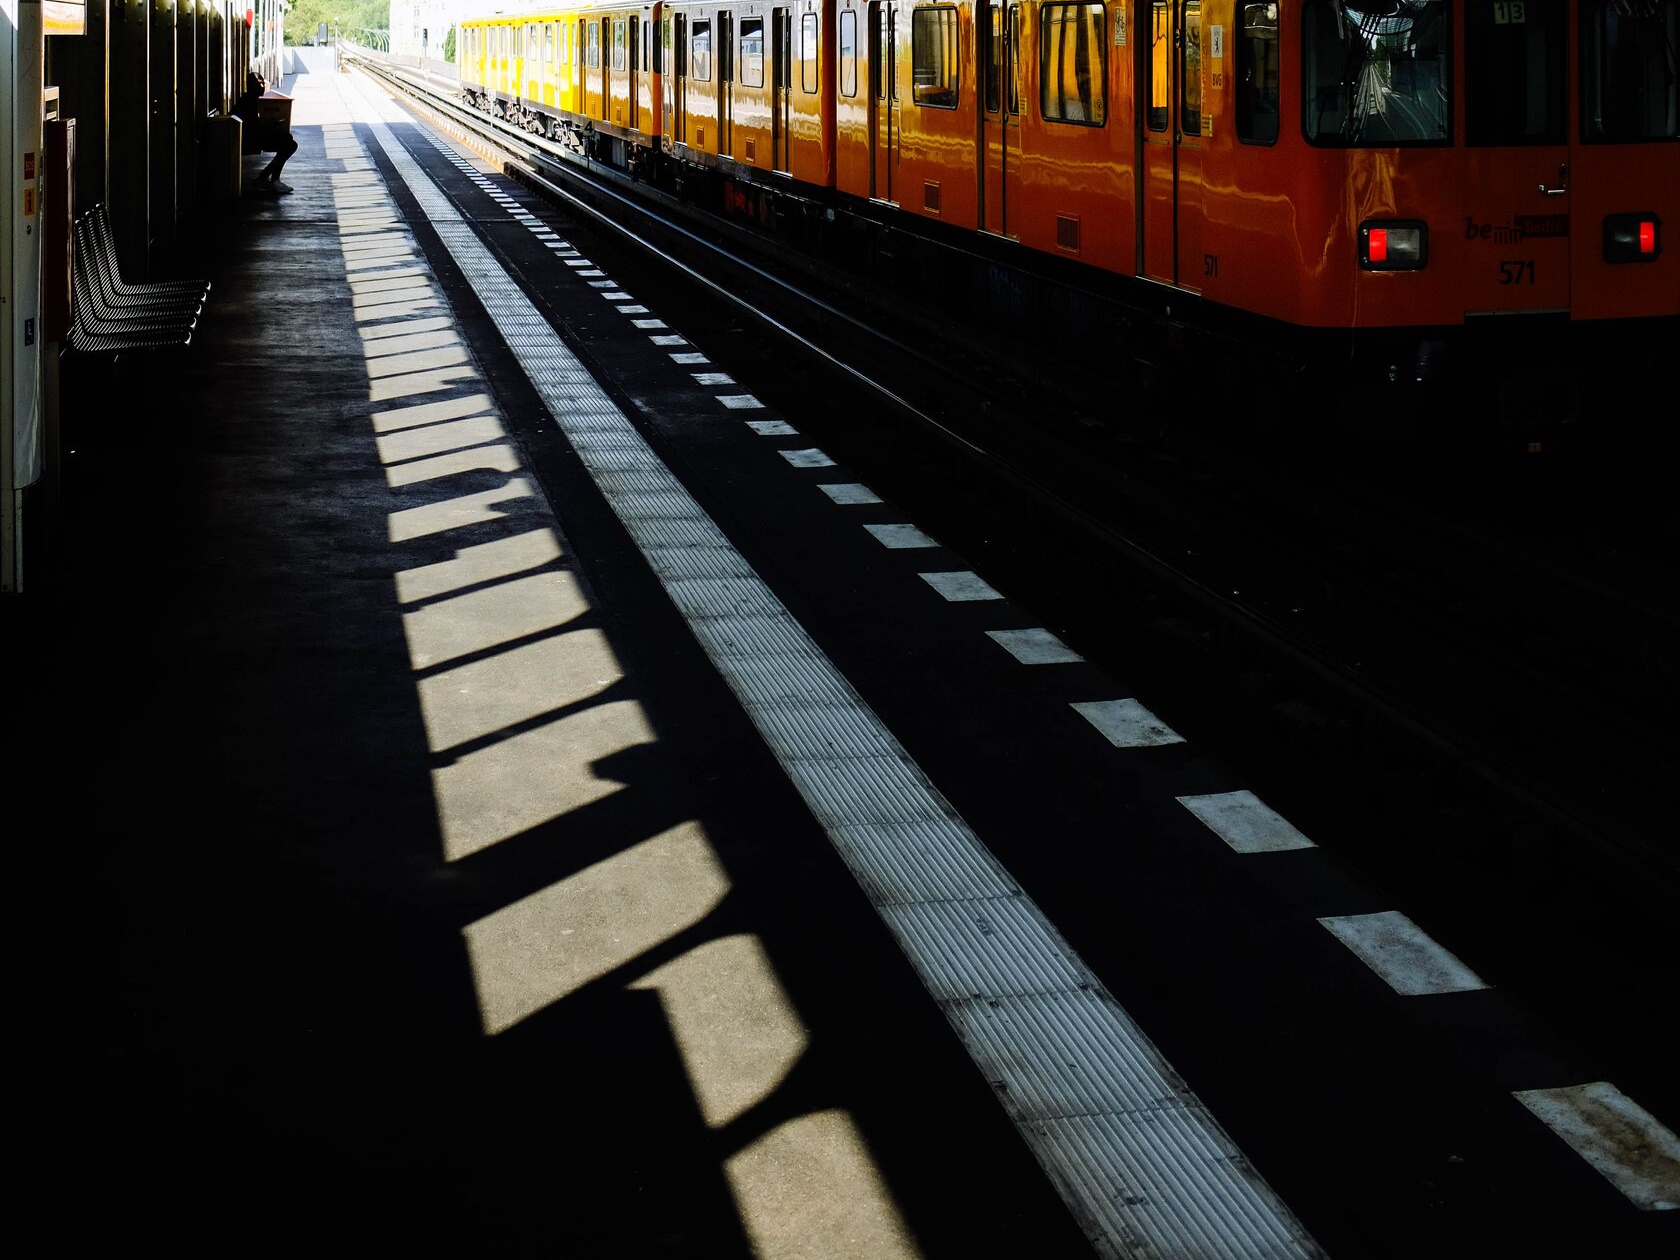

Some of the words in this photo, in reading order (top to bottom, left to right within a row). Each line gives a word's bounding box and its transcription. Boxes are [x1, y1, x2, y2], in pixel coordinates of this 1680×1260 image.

[1498, 4, 1523, 20] 13
[585, 121, 593, 133] 4
[1465, 216, 1493, 240] be
[1204, 254, 1218, 278] 571
[1499, 260, 1536, 285] 571
